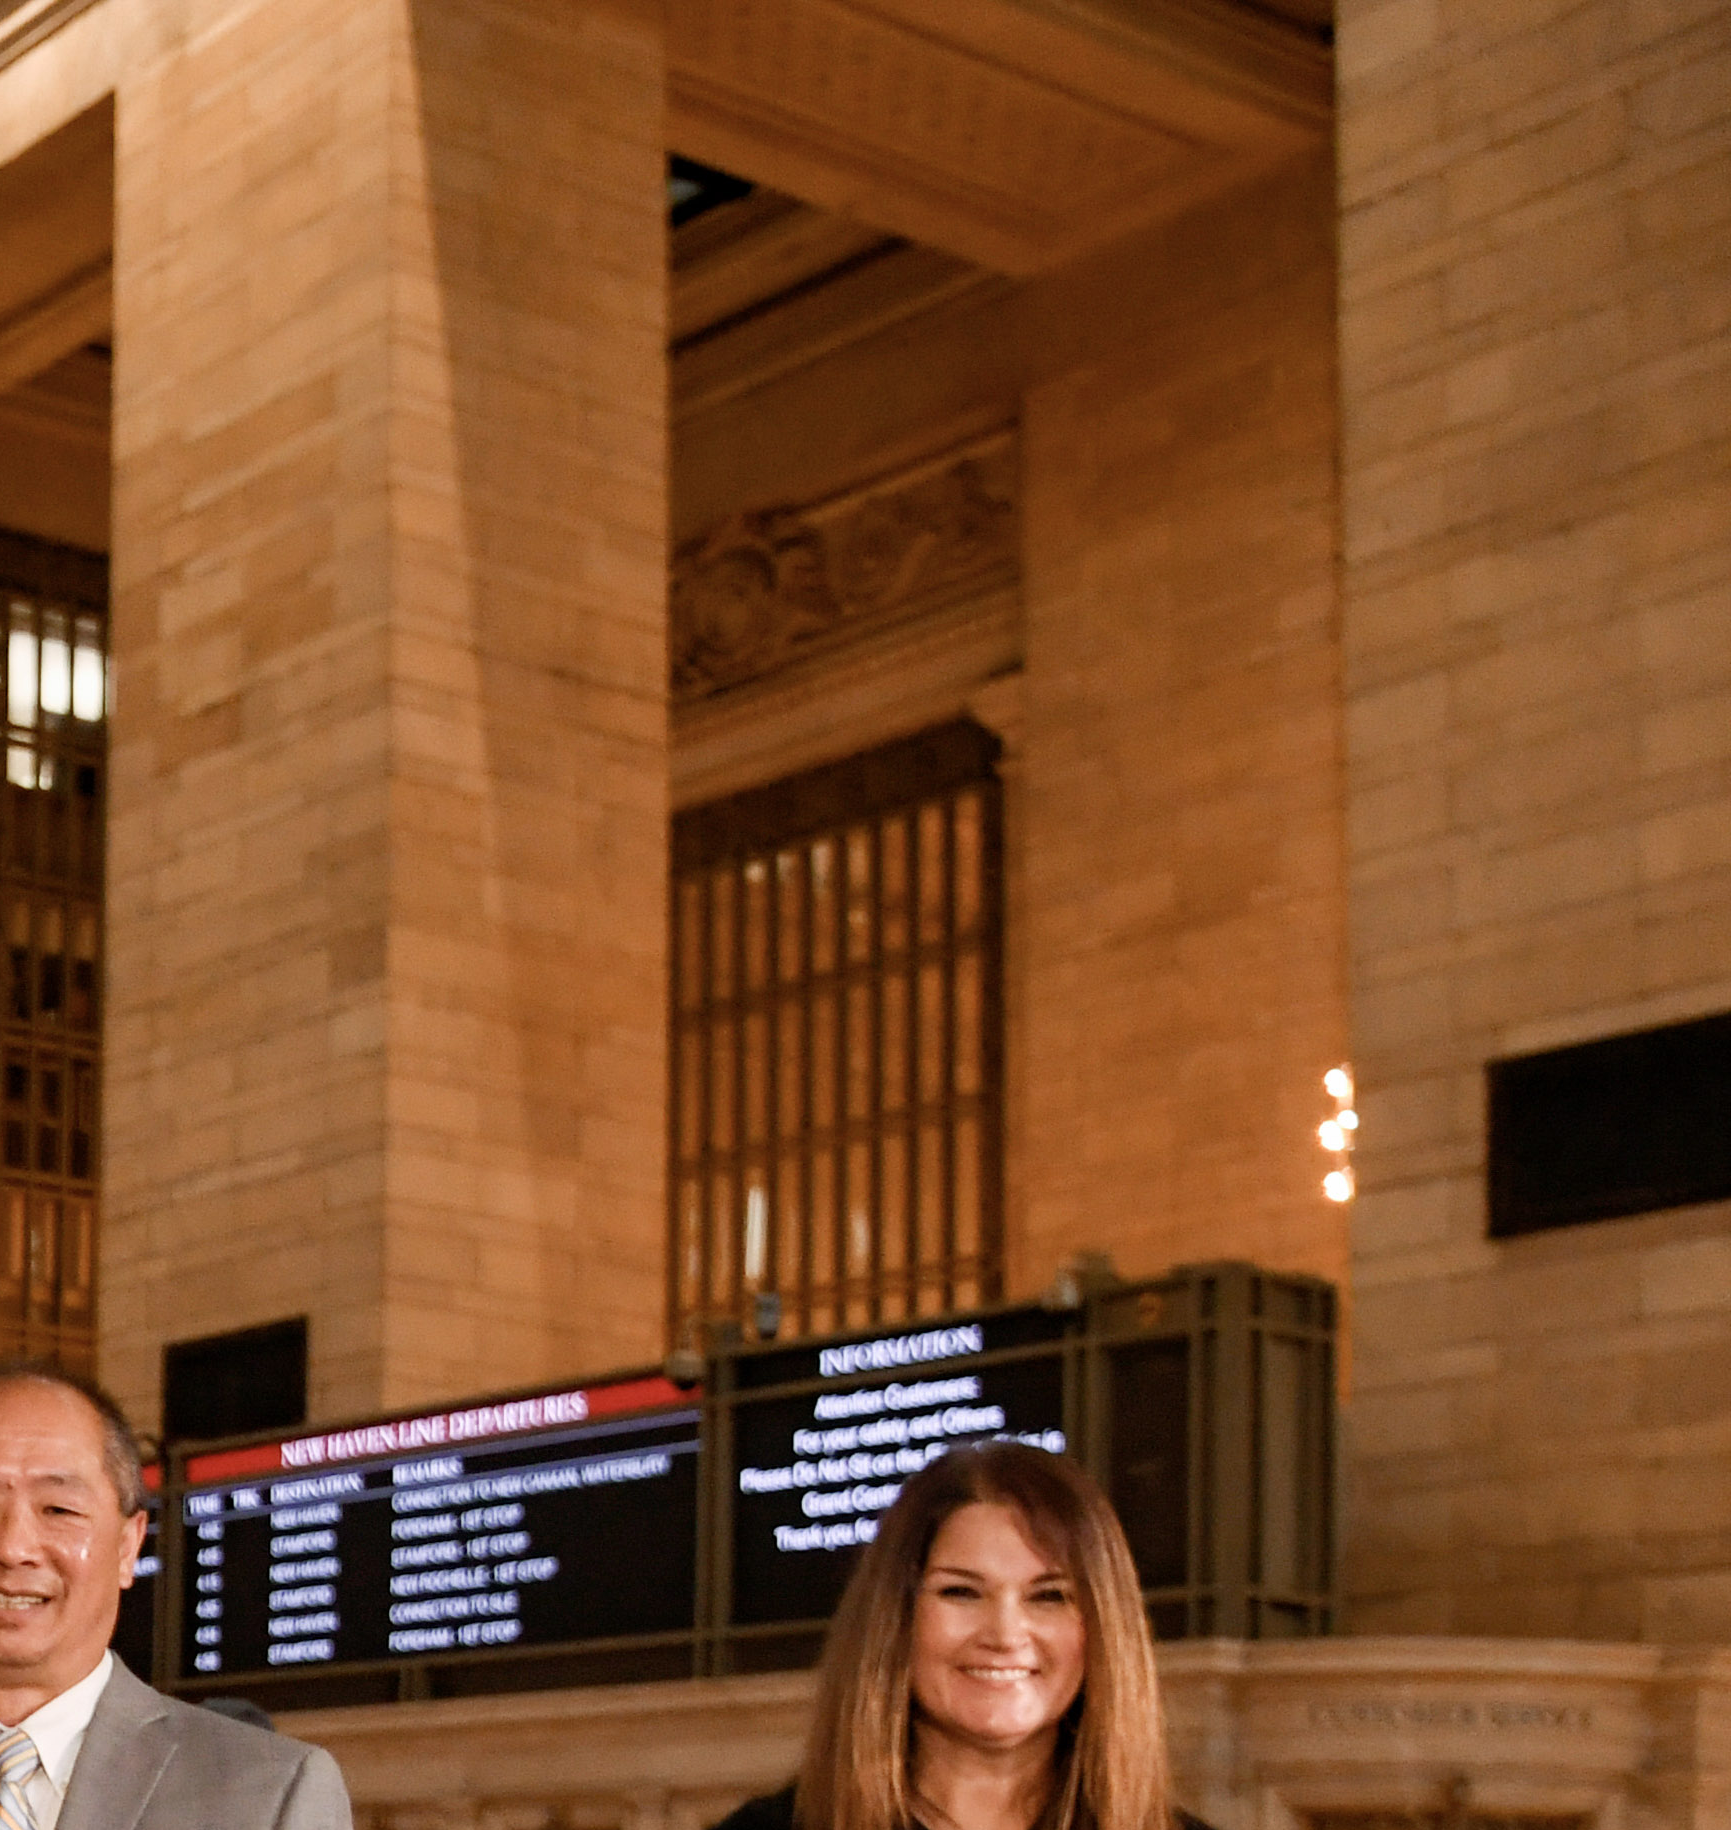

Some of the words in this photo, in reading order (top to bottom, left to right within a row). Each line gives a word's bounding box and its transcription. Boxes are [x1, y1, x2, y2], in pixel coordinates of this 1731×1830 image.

[819, 1323, 984, 1377] INFORMATION
[281, 1435, 328, 1469] NEW
[326, 1423, 399, 1461] HAVEN
[398, 1413, 450, 1448] LINE
[448, 1389, 589, 1441] DEPARTURES
